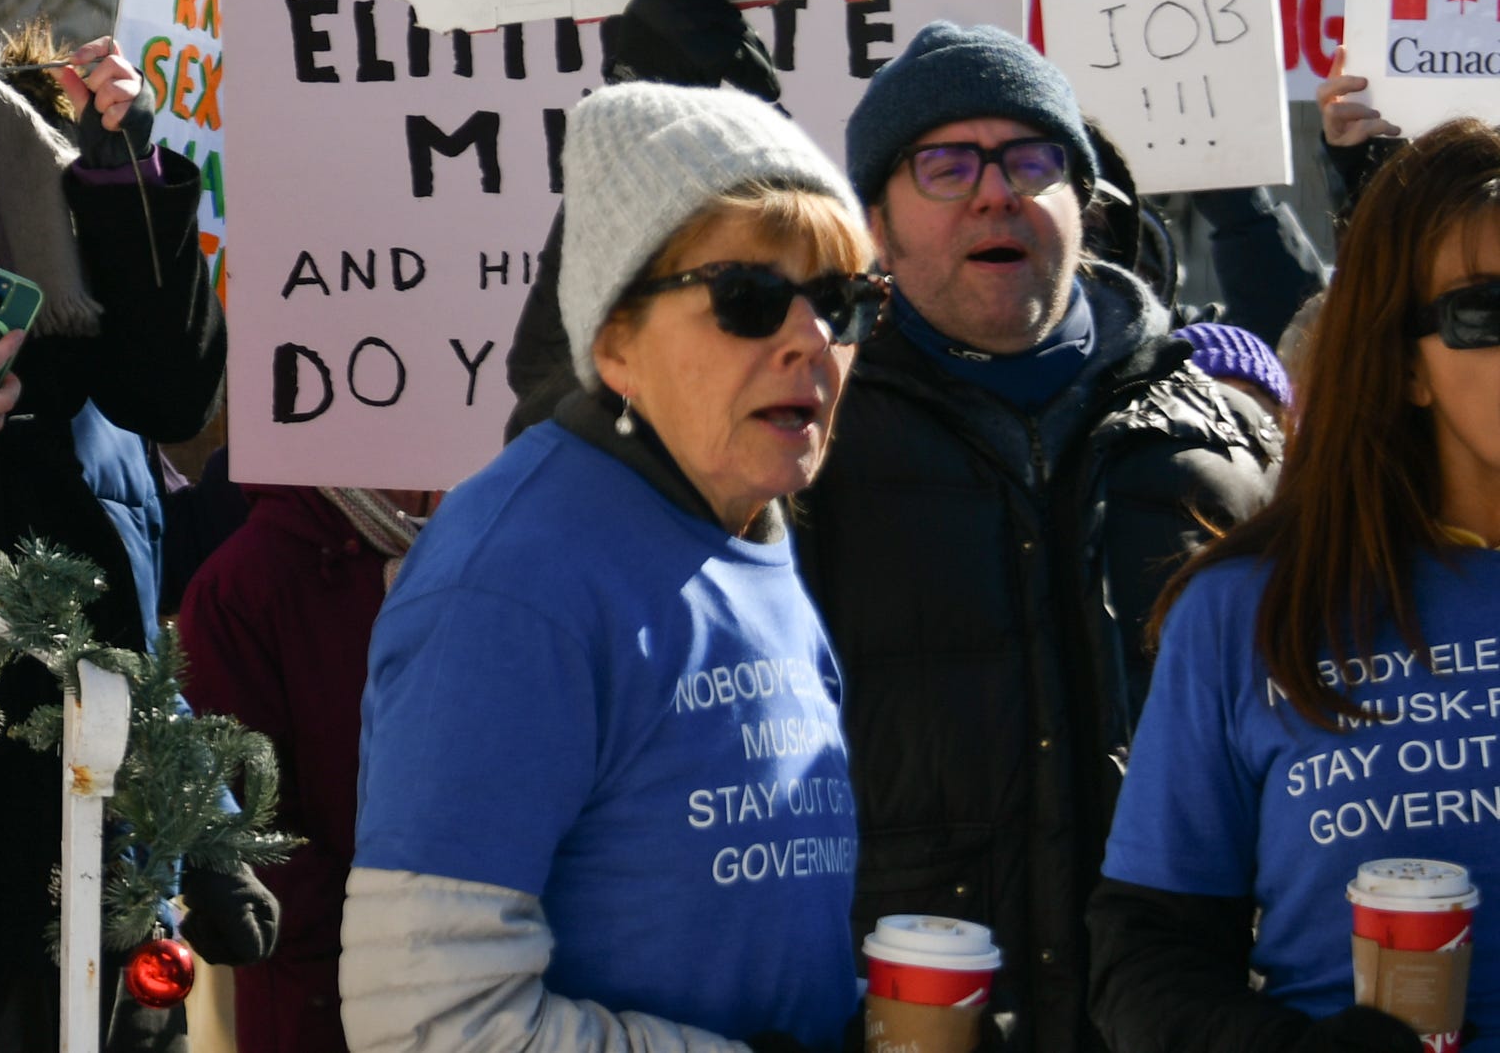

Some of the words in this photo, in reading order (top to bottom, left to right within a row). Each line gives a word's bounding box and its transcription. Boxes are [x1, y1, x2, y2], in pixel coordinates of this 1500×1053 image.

[1142, 75, 1217, 148] !!!
[281, 247, 426, 299] AND
[273, 337, 406, 424] DO
[675, 659, 784, 714] NOBODY
[1267, 650, 1416, 708] NBODY
[1287, 744, 1381, 797] STAY
[1398, 735, 1497, 773] OUT
[688, 781, 779, 827] STAY
[788, 778, 823, 815] OUT
[712, 836, 857, 885] GOVERNME
